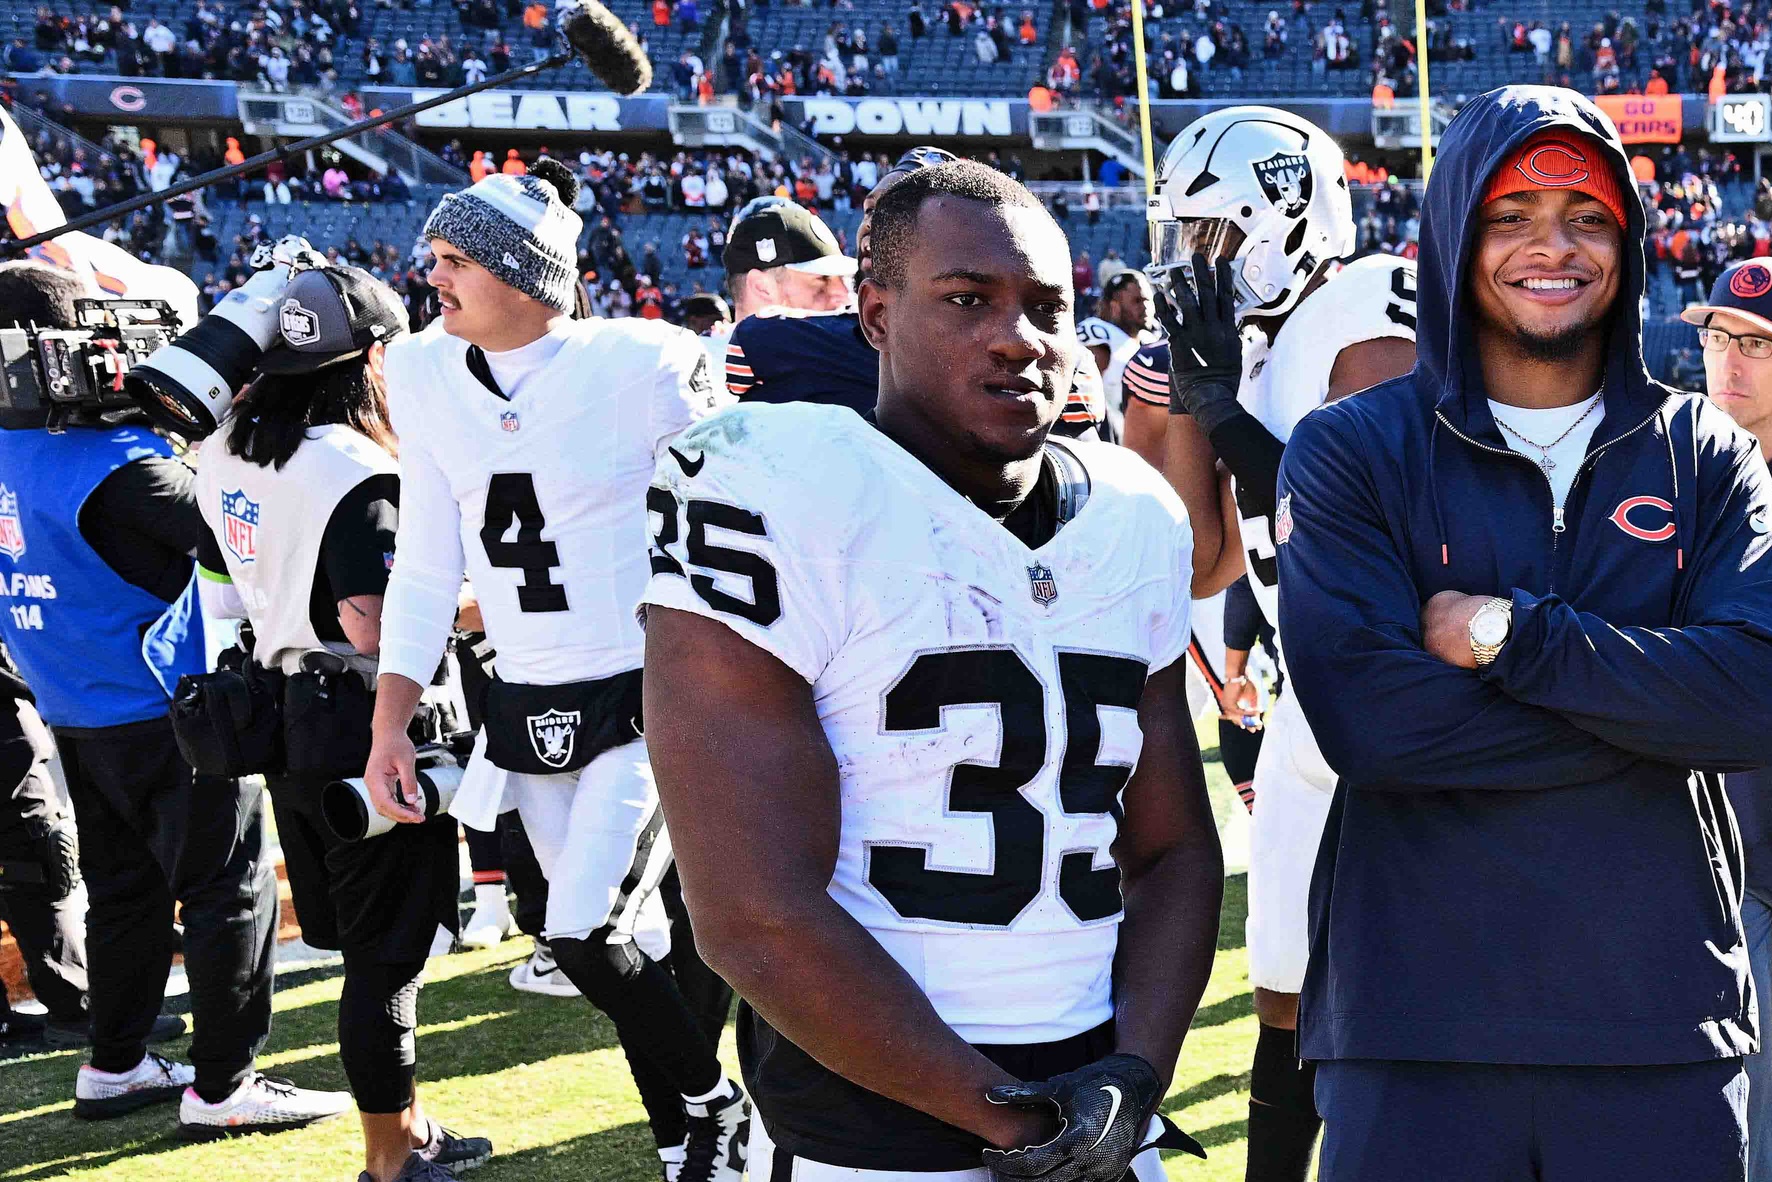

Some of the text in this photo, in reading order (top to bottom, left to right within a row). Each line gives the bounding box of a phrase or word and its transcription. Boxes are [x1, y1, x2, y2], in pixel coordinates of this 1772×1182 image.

[412, 91, 622, 130] BEAR
[803, 99, 1012, 135] DOWN
[1259, 155, 1305, 171] RAIDERS
[226, 515, 257, 555] NFL
[480, 472, 570, 613] 4
[9, 604, 44, 630] 114
[535, 716, 574, 727] RAIDERS
[862, 644, 1152, 930] 35
